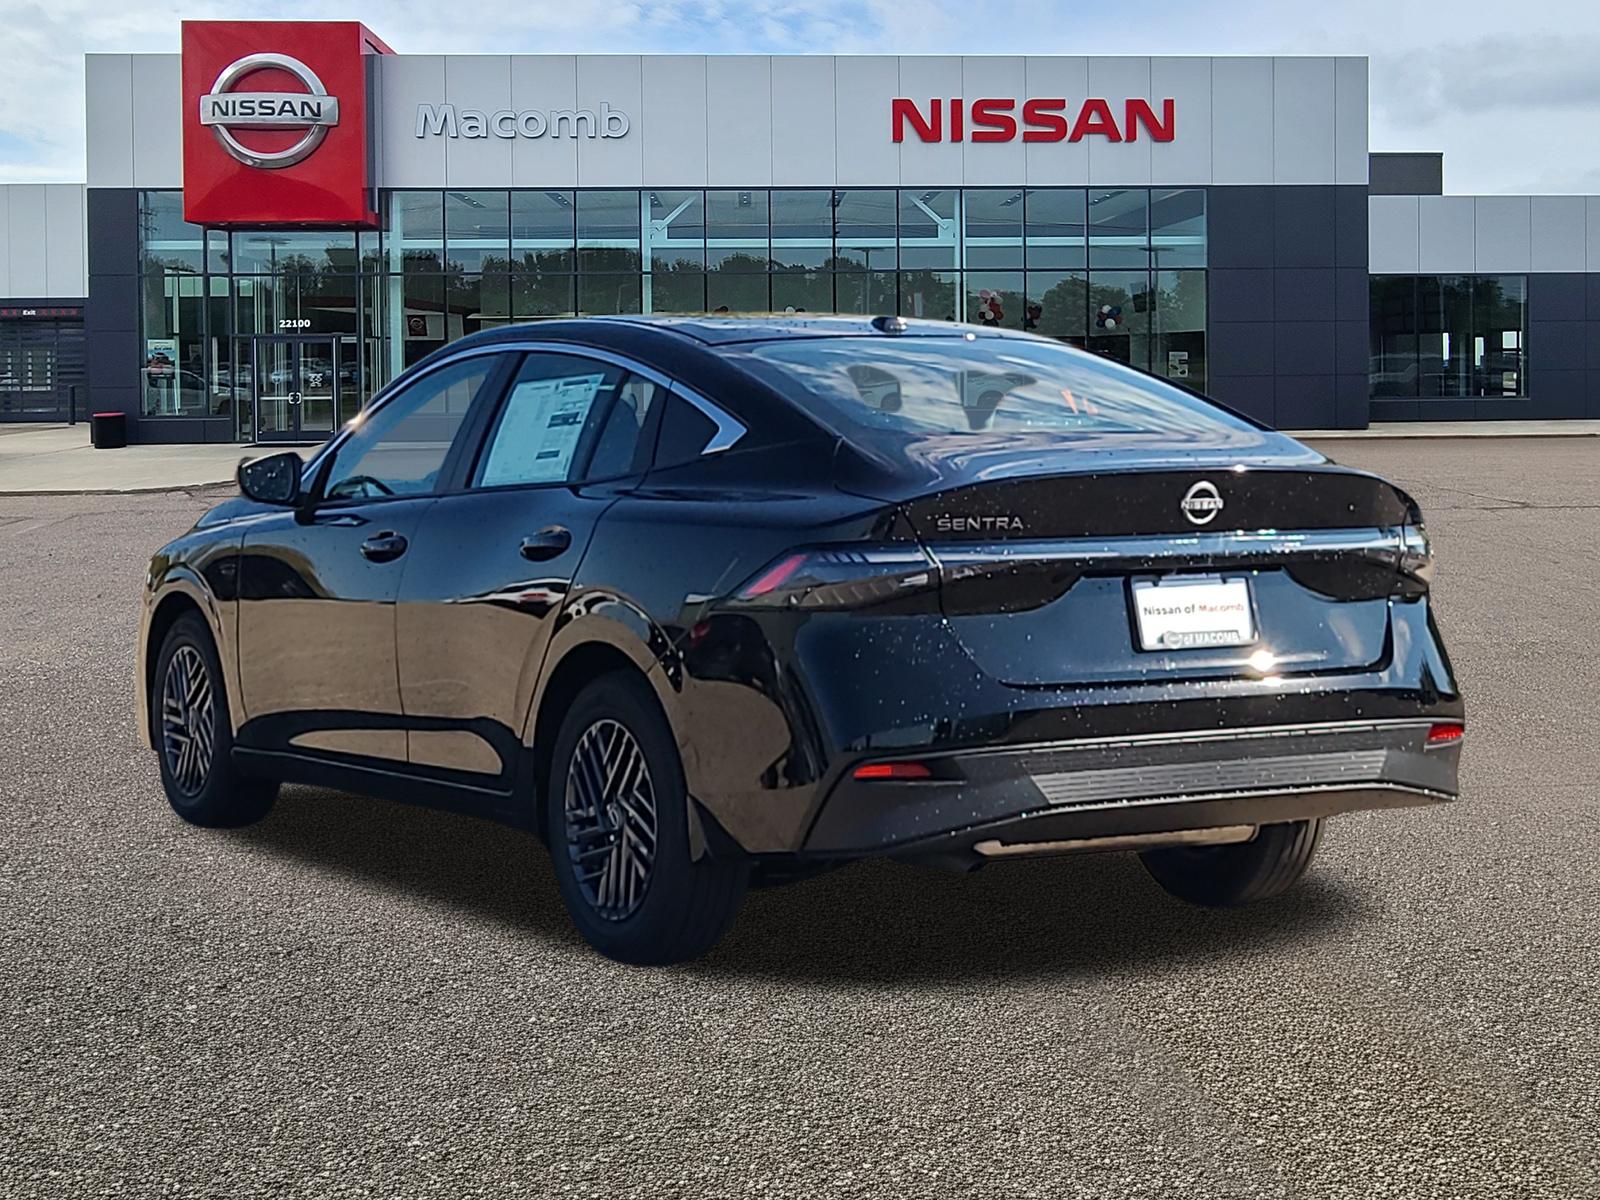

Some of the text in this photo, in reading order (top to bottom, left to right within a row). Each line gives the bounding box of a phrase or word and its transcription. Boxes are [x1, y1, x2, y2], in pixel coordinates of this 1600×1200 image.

[212, 100, 321, 117] NISSAN
[416, 102, 629, 138] Macomb
[892, 98, 1175, 142] NISSAN
[279, 319, 311, 328] 22100
[937, 516, 1024, 531] SENTRA
[1143, 603, 1244, 615] Nissan of Macomb
